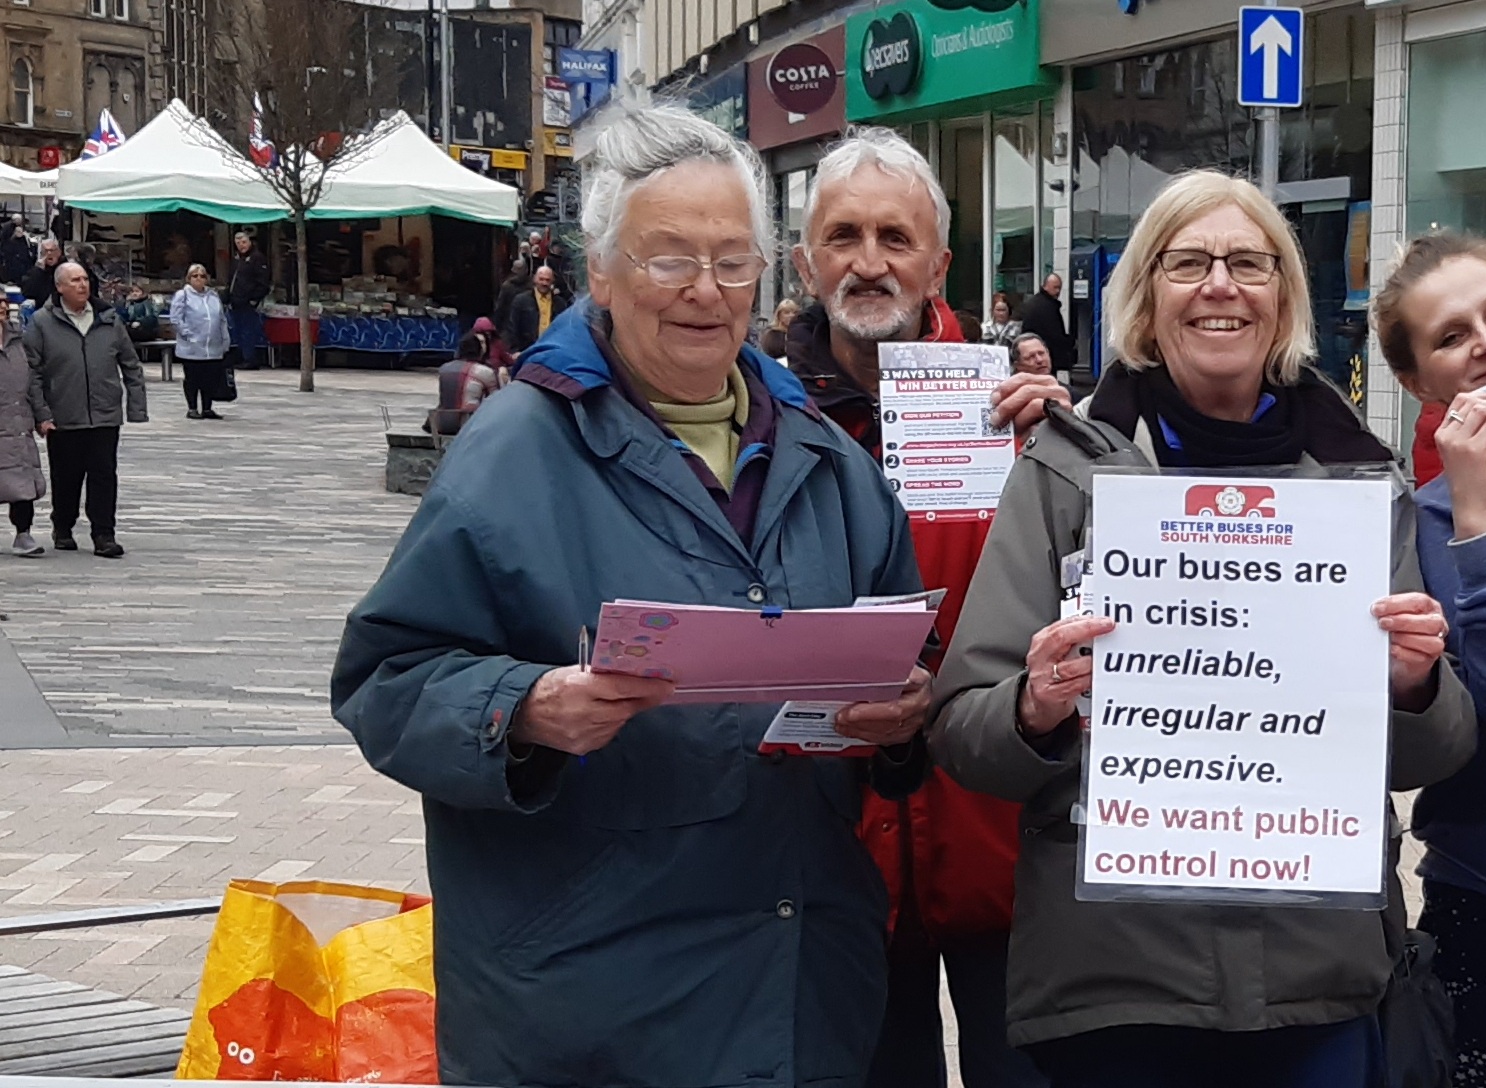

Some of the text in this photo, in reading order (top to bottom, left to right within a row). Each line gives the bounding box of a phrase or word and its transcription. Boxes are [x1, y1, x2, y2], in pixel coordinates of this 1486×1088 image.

[562, 61, 607, 72] HALIFAX
[774, 64, 830, 83] COSTA
[882, 369, 976, 379] 3 WAYS TO HELP
[899, 382, 921, 391] WIN
[922, 381, 967, 390] BETTER
[1160, 521, 1294, 534] BETTER BUSES FOR
[1160, 532, 1293, 545] SOUTH YORKSHIRE
[1103, 549, 1348, 584] Our buses are
[1103, 596, 1249, 628] in crisis:
[1103, 649, 1281, 684] unreliable,
[1101, 699, 1326, 736] irregular and
[1099, 753, 1283, 784] expensive.
[1098, 797, 1359, 840] We want public
[1095, 850, 1310, 882] control now!
